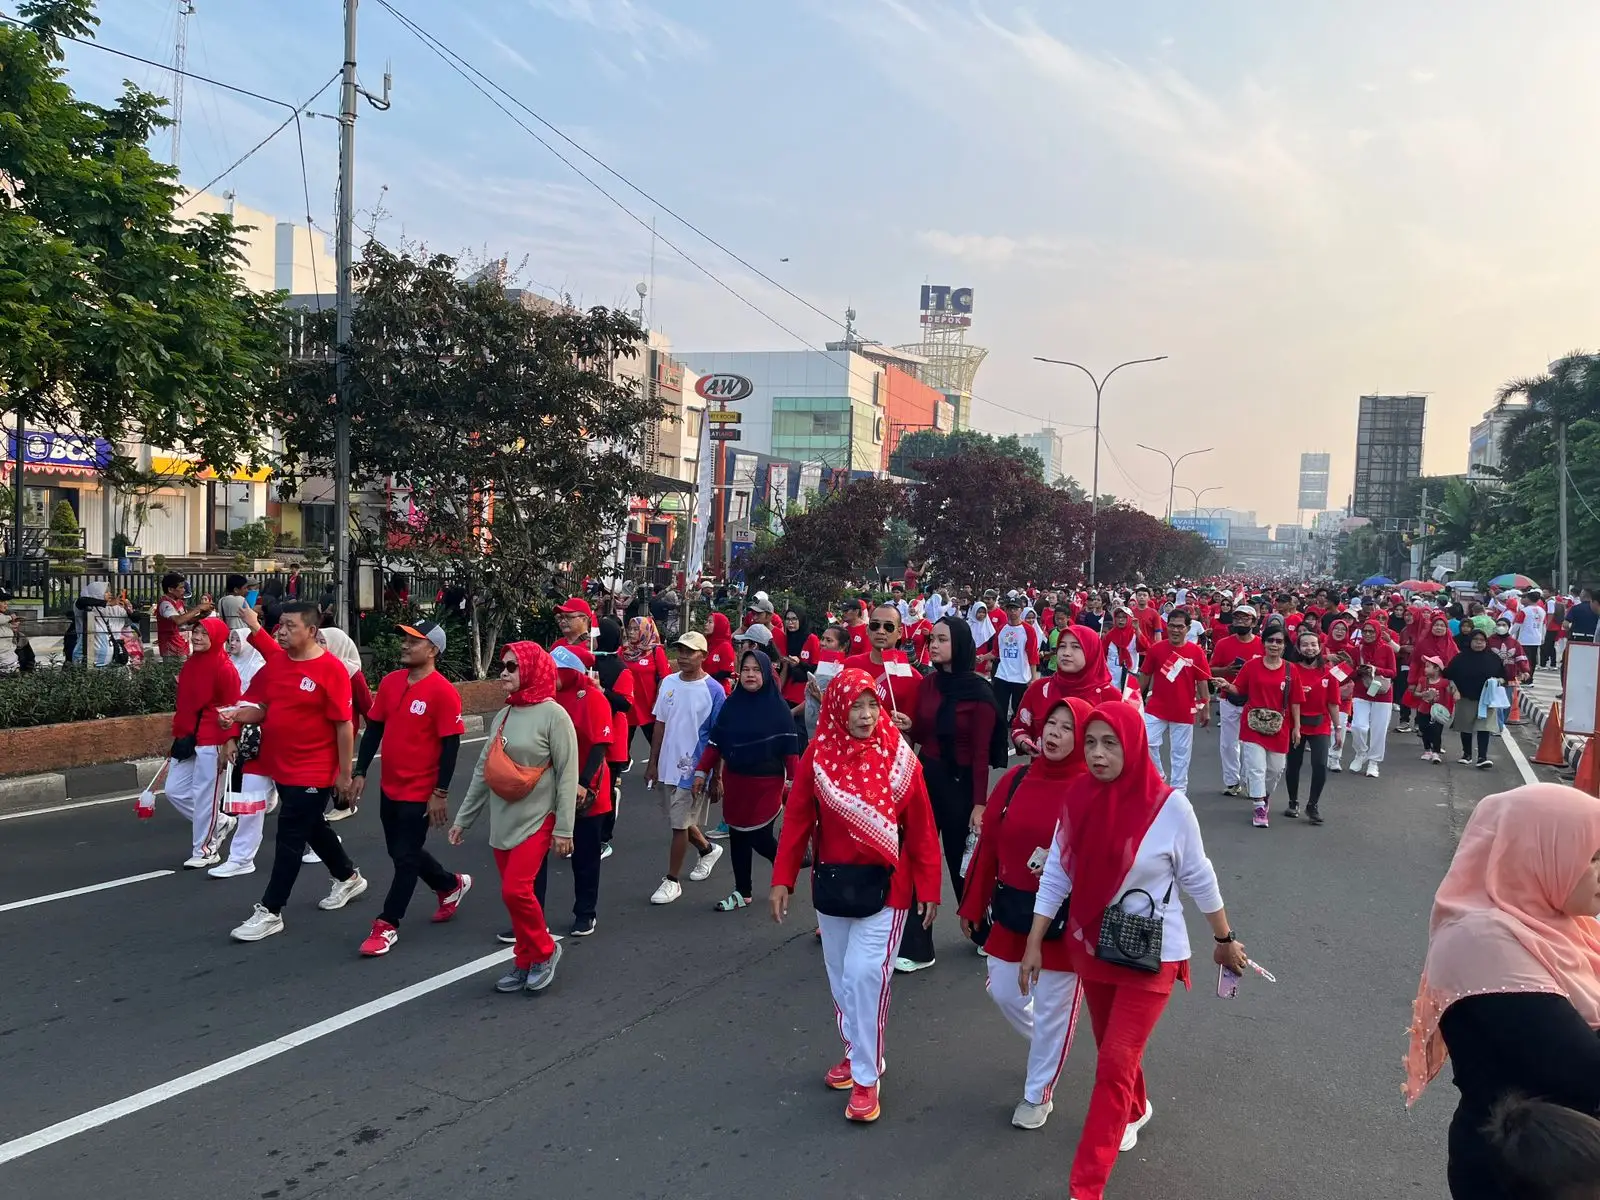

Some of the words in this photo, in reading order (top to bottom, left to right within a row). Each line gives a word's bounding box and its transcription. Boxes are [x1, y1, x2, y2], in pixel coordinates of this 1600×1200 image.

[920, 285, 973, 314] ITC
[928, 316, 961, 324] DEPOK
[50, 438, 97, 461] BCA
